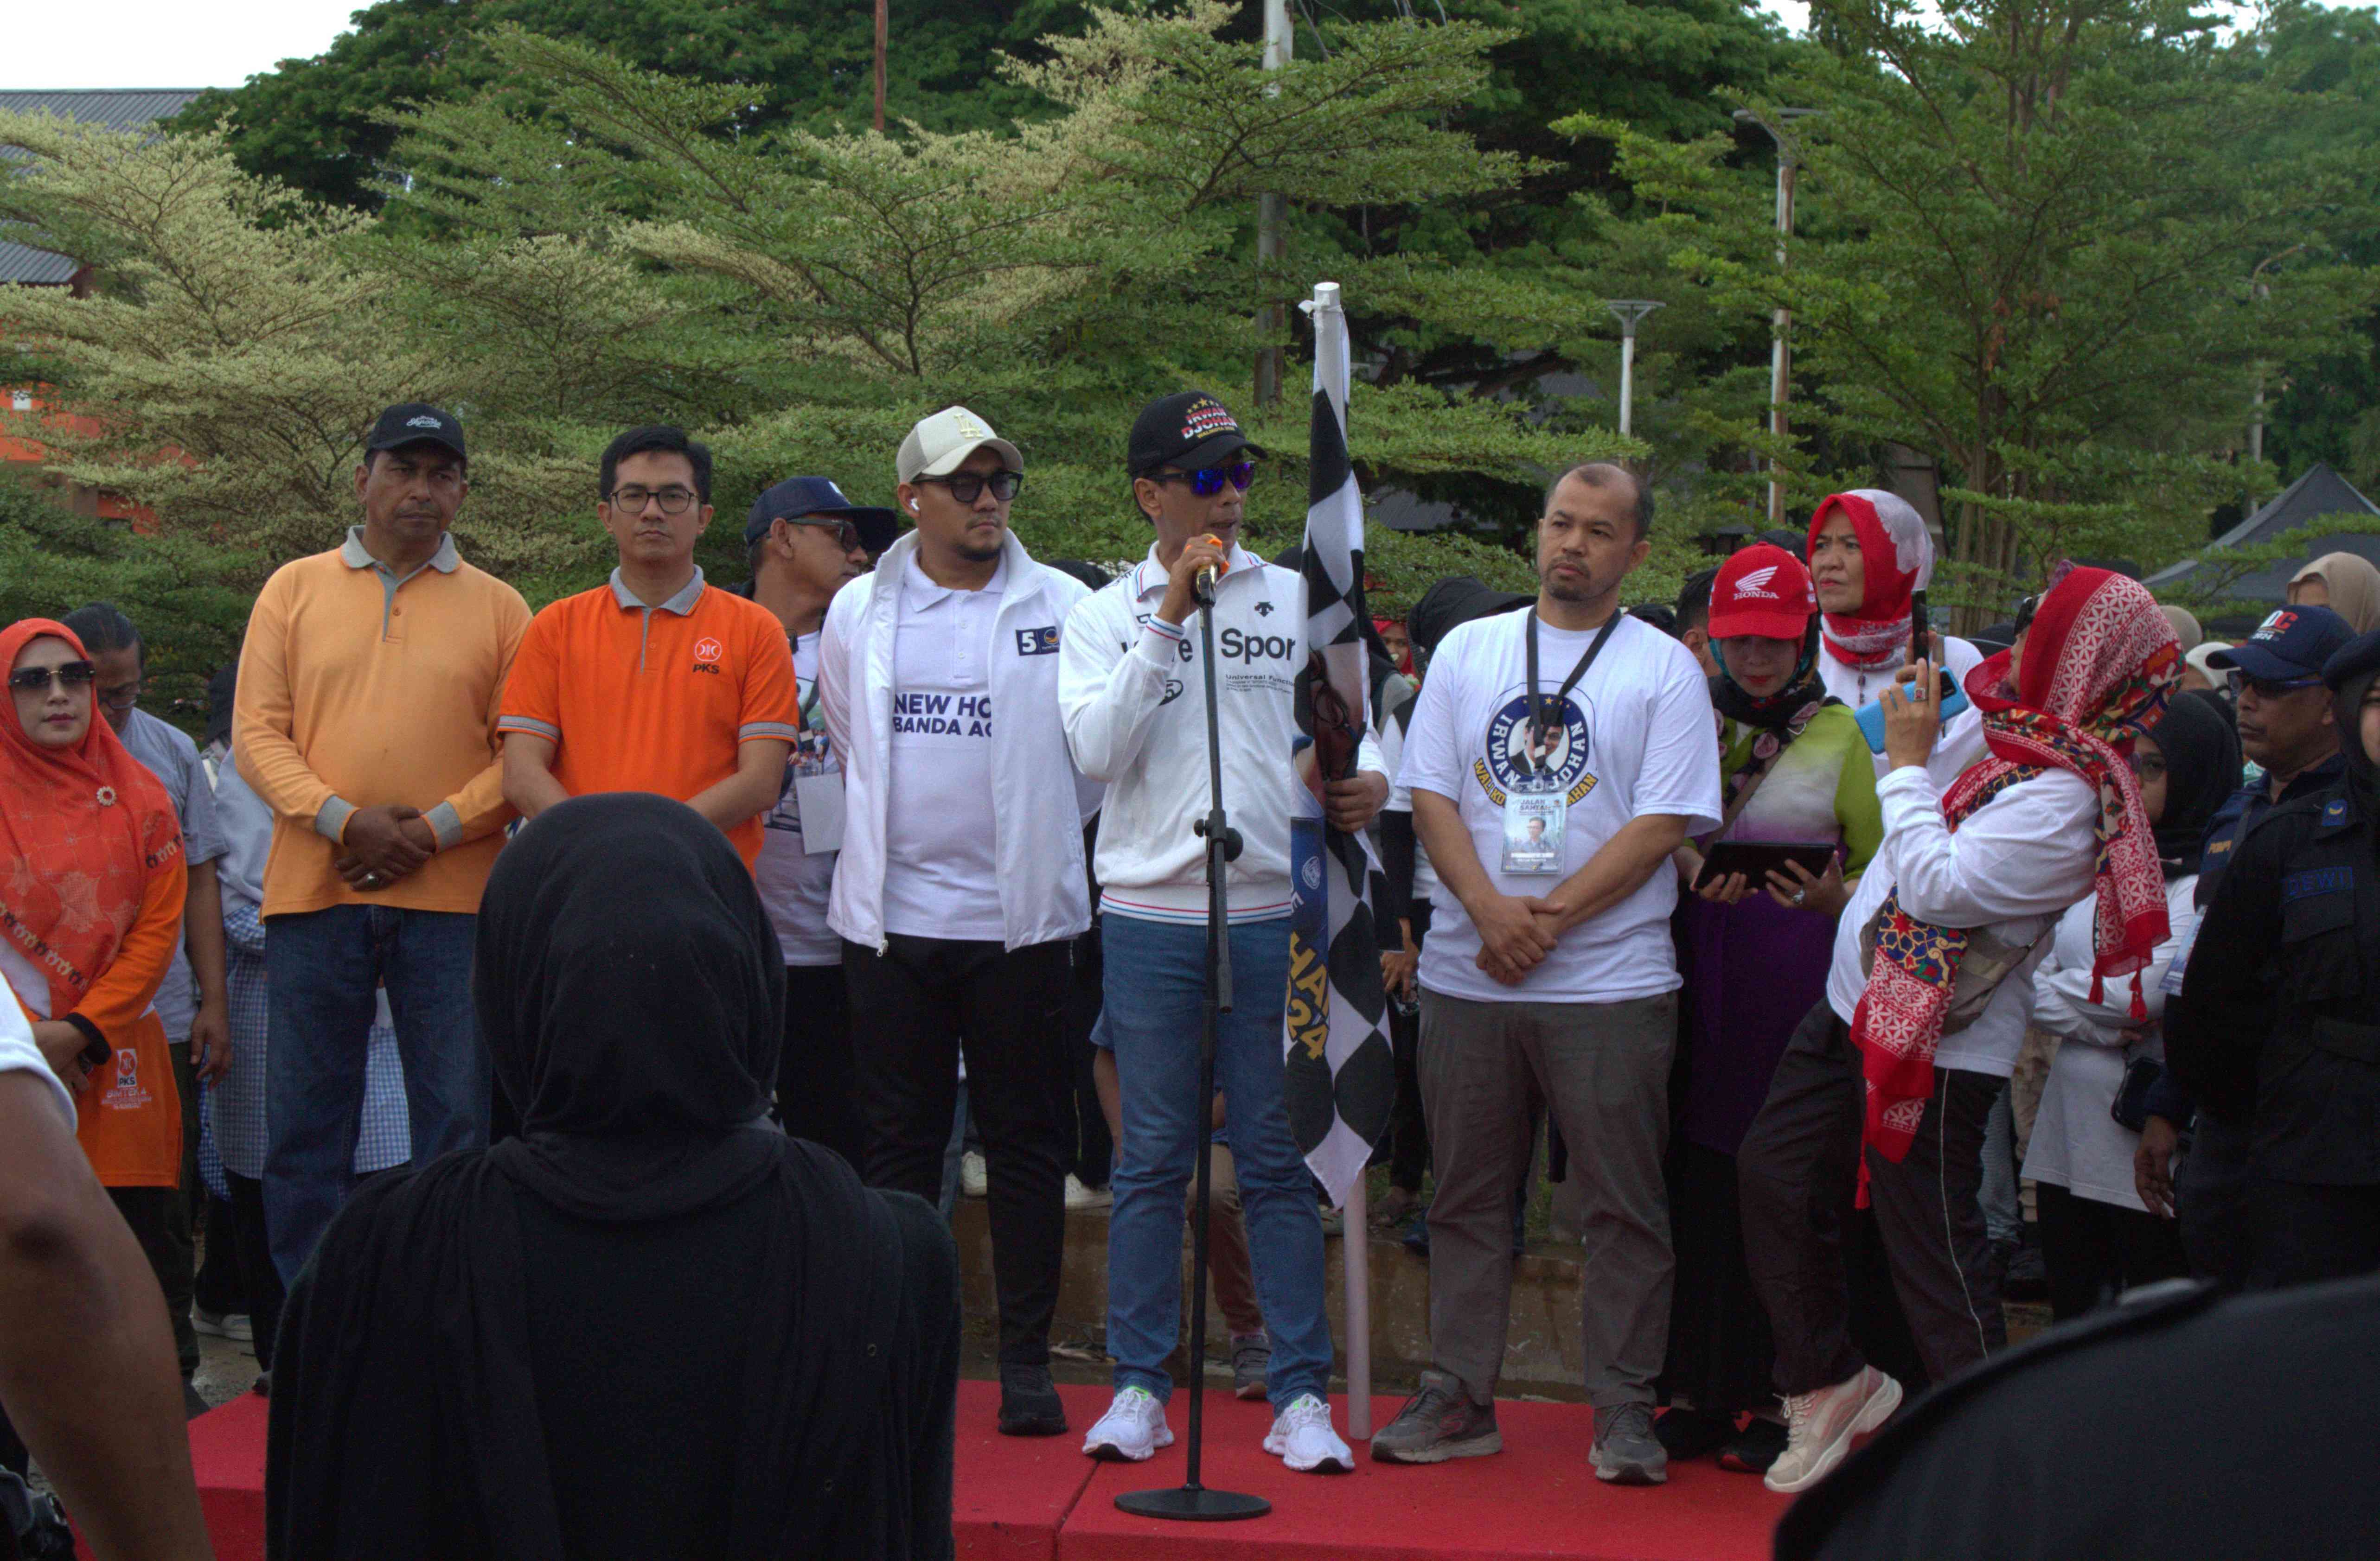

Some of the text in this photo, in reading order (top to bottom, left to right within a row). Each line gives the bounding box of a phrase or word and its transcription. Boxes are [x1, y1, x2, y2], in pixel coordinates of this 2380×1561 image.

[1186, 408, 1227, 425] IRWAN
[1181, 416, 1238, 439] DJOHAN
[1734, 591, 1780, 600] HONDA
[1022, 631, 1036, 653] 5
[692, 663, 720, 675] PKS
[894, 694, 952, 714] NEW
[893, 717, 961, 735] BANDA
[1491, 714, 1521, 786] IRWAN
[119, 1077, 135, 1086] PKS
